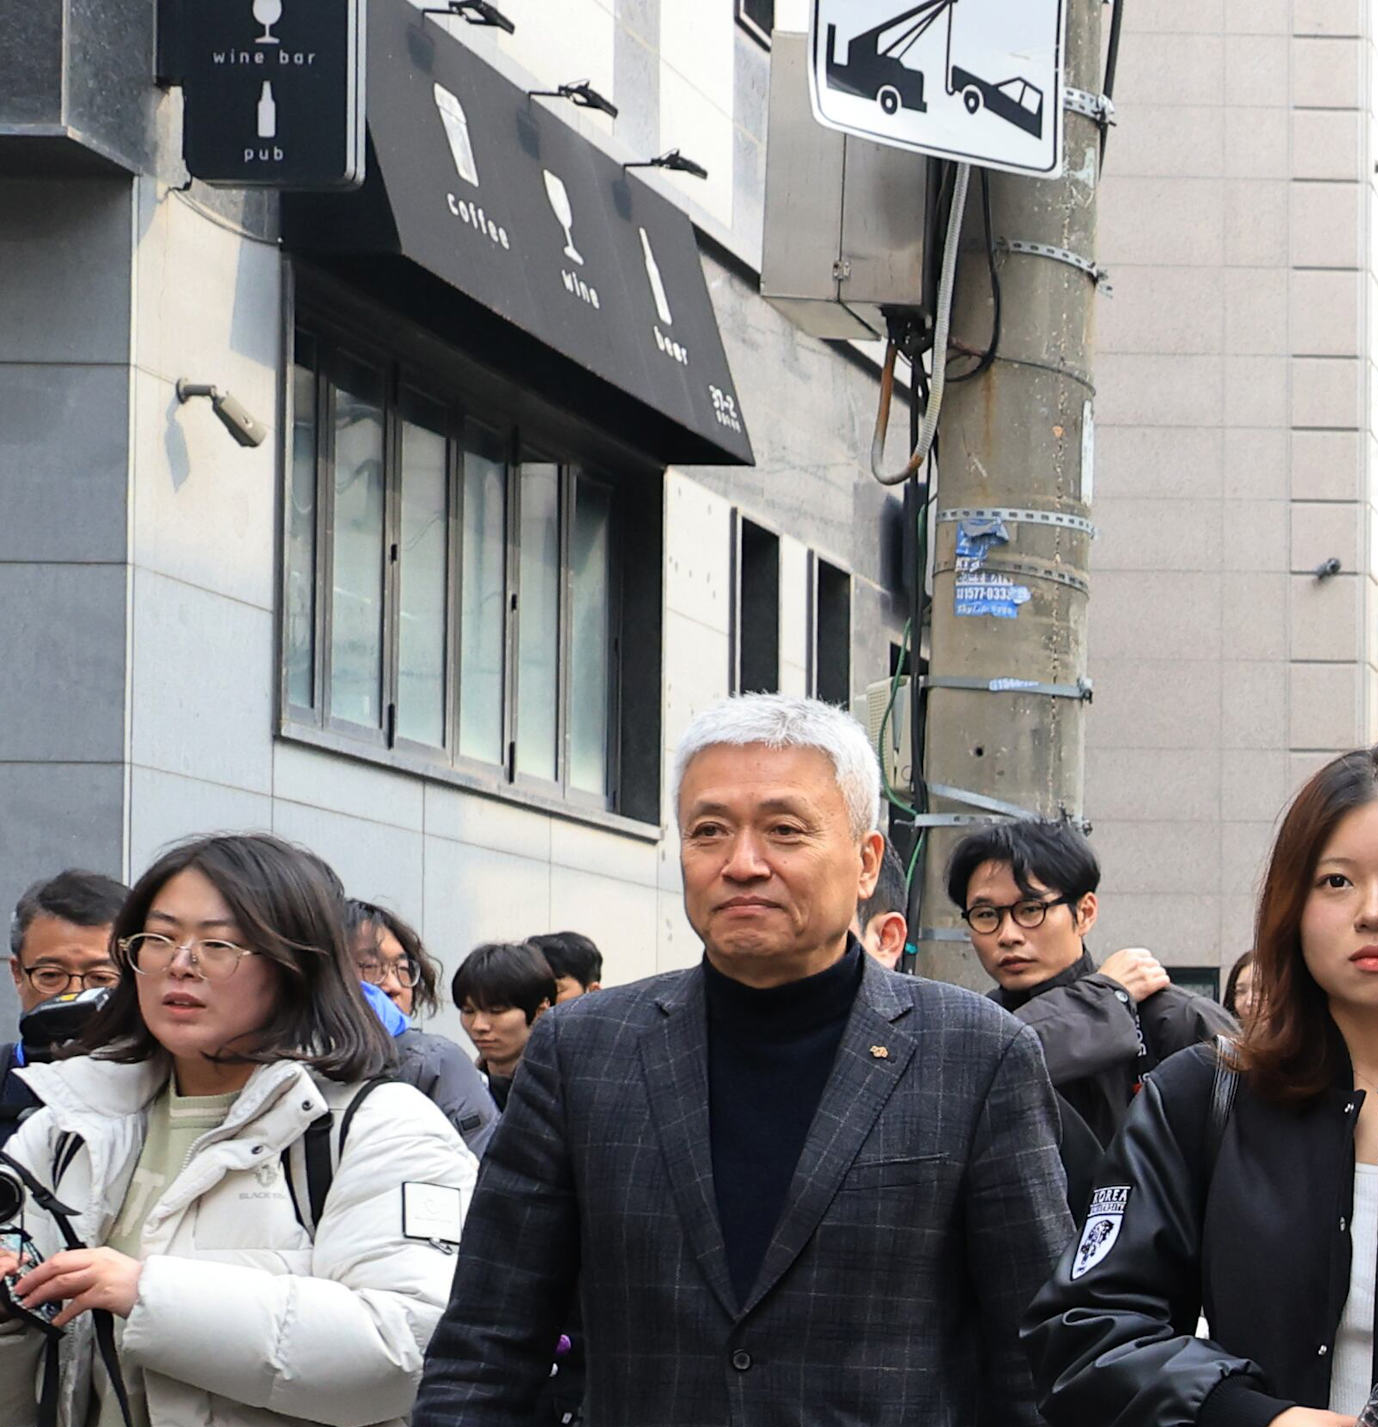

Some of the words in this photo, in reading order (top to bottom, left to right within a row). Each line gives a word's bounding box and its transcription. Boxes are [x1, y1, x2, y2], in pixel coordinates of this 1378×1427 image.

[213, 48, 265, 64] wine
[279, 49, 316, 65] bar
[244, 146, 284, 163] pub
[447, 193, 510, 250] coffee
[561, 269, 600, 309] wine
[654, 325, 689, 365] beer
[1094, 1189, 1128, 1203] KOREA
